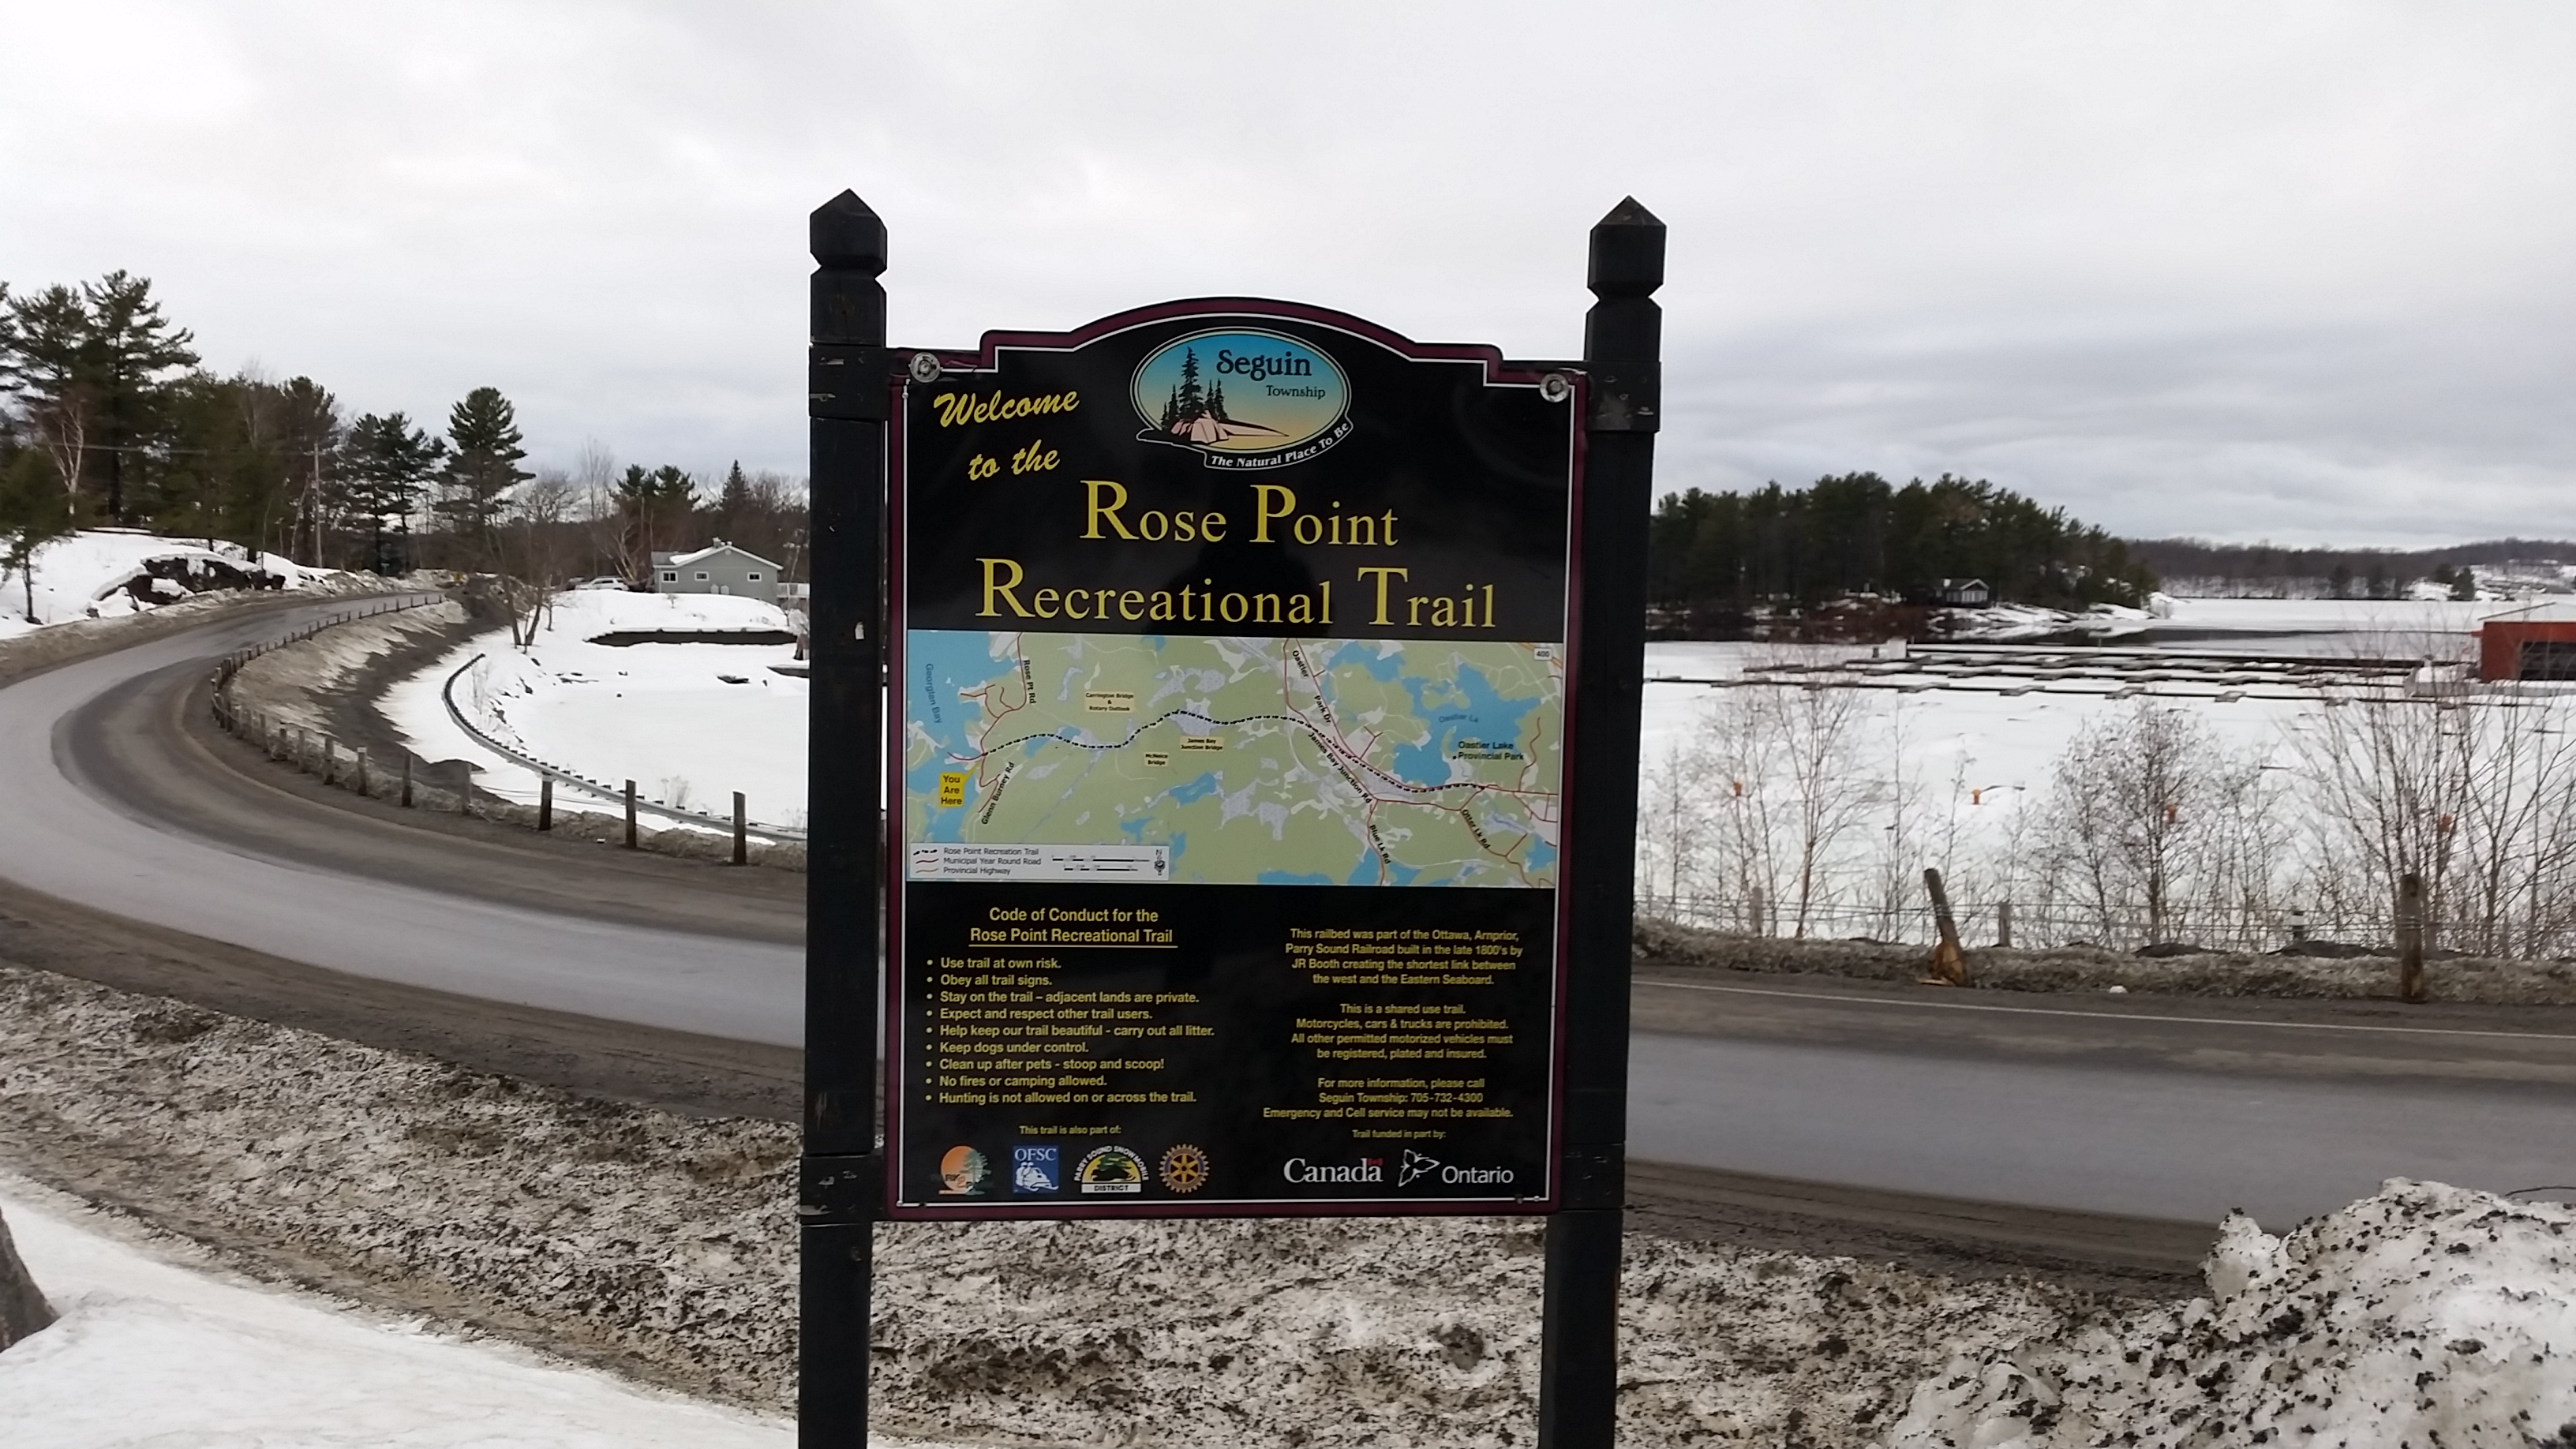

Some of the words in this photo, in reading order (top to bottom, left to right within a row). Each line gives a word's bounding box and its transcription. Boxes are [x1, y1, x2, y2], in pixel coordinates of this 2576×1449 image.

[1216, 349, 1312, 382] Seguin
[1265, 384, 1326, 400] Township
[933, 385, 1080, 428] Welcome
[1211, 455, 1233, 467] The
[1237, 455, 1282, 468] Natural
[1286, 444, 1317, 462] Place
[1318, 436, 1334, 451] To
[1334, 422, 1350, 439] Be
[968, 451, 999, 481] to
[1012, 439, 1061, 475] the
[1079, 479, 1226, 542] Rose
[1249, 485, 1399, 546] Point
[975, 558, 1335, 627] Recreational
[1357, 567, 1496, 628] Trail
[1027, 682, 1034, 691] Pt
[1292, 650, 1309, 678] Oastler
[1313, 695, 1327, 713] Park
[1322, 713, 1331, 724] Dr
[926, 664, 935, 706] Georgian
[932, 706, 942, 724] Bay
[1028, 692, 1036, 704] Rd
[1308, 732, 1327, 754] James
[1327, 753, 1339, 768] Bay
[1338, 766, 1363, 794] Junction
[1361, 792, 1373, 804] Rd
[943, 775, 960, 784] You
[941, 796, 962, 805] Here
[981, 802, 997, 825] Glenn
[992, 774, 1010, 802] Burney
[1005, 762, 1015, 773] Rd
[1462, 809, 1477, 829] Otter
[1481, 838, 1491, 849] Rd
[1369, 824, 1380, 842] Blue
[1382, 852, 1391, 864] Rd
[943, 857, 978, 866] Municipal
[979, 867, 1011, 876] Highway
[990, 907, 1027, 921] Code
[1031, 908, 1046, 921] of
[1049, 908, 1109, 921] Conduct
[1112, 908, 1133, 922] for
[1136, 909, 1159, 922] the
[971, 928, 1006, 941] Rose
[1011, 928, 1047, 941] Point
[1051, 928, 1139, 942] Recreational
[1143, 929, 1172, 942] Trail
[941, 957, 964, 968] Use
[967, 957, 990, 968] trail
[993, 958, 1005, 968] at
[1036, 957, 1061, 968] risk.
[941, 974, 972, 987] Obey
[975, 975, 988, 985] all
[991, 975, 1014, 985] trail
[1017, 975, 1052, 987] signs.
[1312, 974, 1330, 983] the
[1332, 975, 1357, 983] west
[1359, 974, 1379, 983] and
[1381, 974, 1398, 983] the
[1401, 974, 1440, 984] Eastern
[1443, 974, 1494, 984] Seaboard.
[940, 991, 967, 1004] Stay
[988, 991, 1007, 1002] the
[1010, 991, 1033, 1002] trail
[1046, 991, 1097, 1004] adjacent
[1099, 991, 1131, 1002] lands
[1156, 992, 1199, 1005] private.
[940, 1008, 982, 1021] Expect
[984, 1008, 1007, 1019] and
[1010, 1009, 1054, 1020] respect
[1058, 1009, 1089, 1019] other
[1091, 1009, 1114, 1019] trail
[1340, 1004, 1362, 1013] This
[1365, 1004, 1373, 1013] is
[1385, 1004, 1420, 1013] shared
[1443, 1005, 1466, 1013] trail.
[940, 1024, 968, 1038] Help
[971, 1025, 1000, 1038] keep
[1026, 1025, 1048, 1035] trail
[1051, 1025, 1103, 1035] beautiful
[1114, 1028, 1144, 1038] carry
[1147, 1026, 1166, 1035] out
[1169, 1025, 1182, 1035] all
[1185, 1025, 1214, 1035] litter.
[940, 1042, 971, 1054] Keep
[974, 1042, 1004, 1054] dogs
[1007, 1042, 1042, 1052] under
[1044, 1042, 1088, 1052] control.
[940, 1058, 974, 1069] Clean
[977, 1061, 992, 1072] up
[995, 1058, 1024, 1069] after
[1026, 1059, 1052, 1072] pets
[1063, 1059, 1097, 1071] stoop
[1099, 1058, 1121, 1069] and
[1125, 1058, 1164, 1071] scoop!
[940, 1076, 957, 1086] No
[960, 1076, 986, 1086] fires
[1005, 1075, 1055, 1088] camping
[1058, 1075, 1107, 1086] allowed.
[1318, 1078, 1335, 1088] For
[1367, 1078, 1428, 1089] information,
[1431, 1078, 1464, 1089] please
[1466, 1078, 1485, 1088] call
[939, 1092, 986, 1105] Hunting
[989, 1092, 999, 1103] is
[1002, 1092, 1022, 1103] not
[1024, 1091, 1070, 1103] allowed
[1149, 1091, 1168, 1102] the
[1171, 1091, 1196, 1102] trail.
[1319, 1092, 1354, 1105] Seguin
[1357, 1092, 1408, 1104] Township:
[1410, 1093, 1483, 1103] 705-732-4300
[1014, 1148, 1057, 1161] OFSC
[1073, 1159, 1089, 1181] PARRY
[1283, 1158, 1384, 1183] Canada
[1442, 1166, 1515, 1184] Ontario
